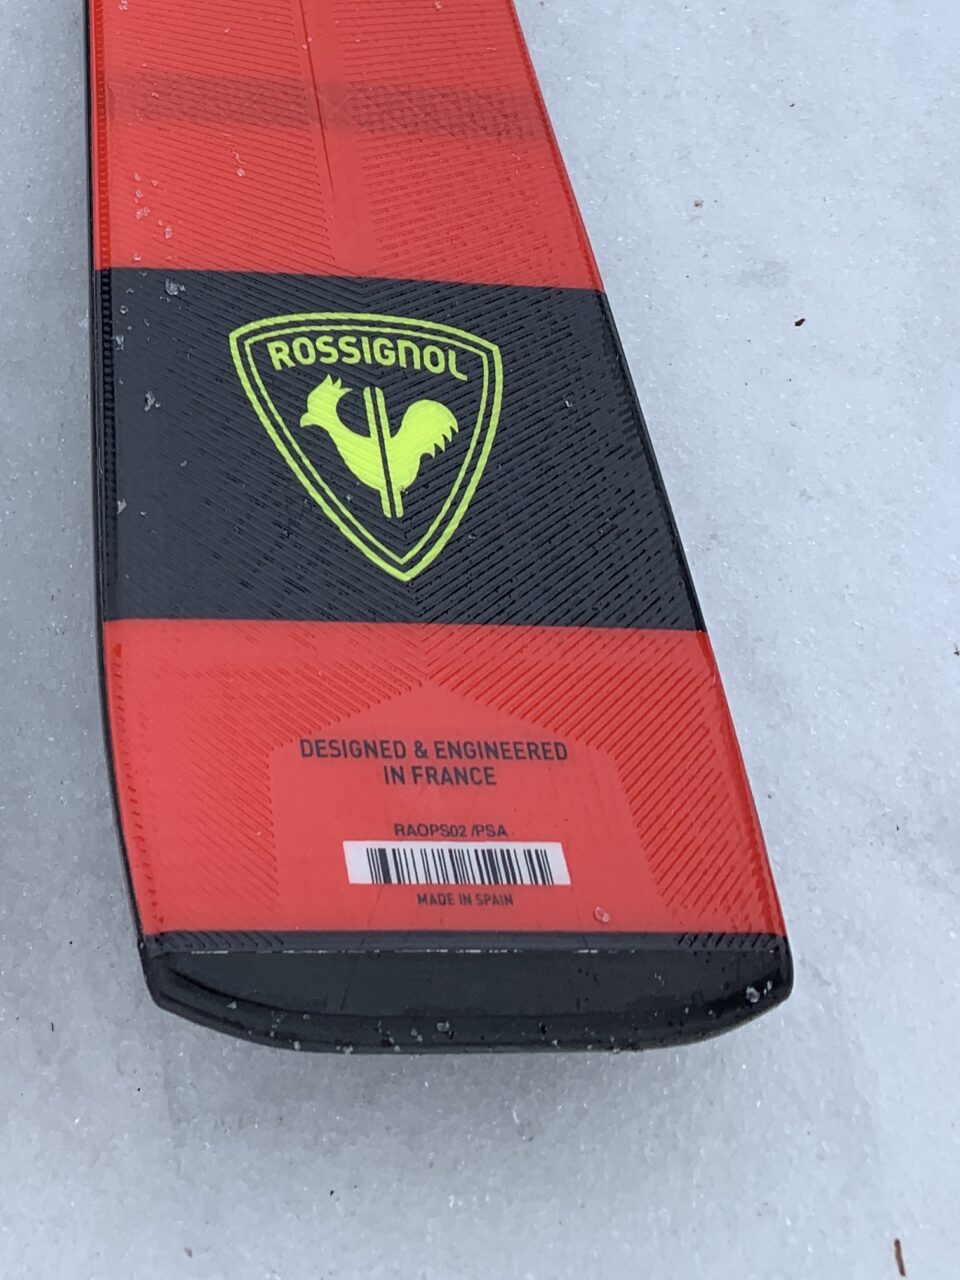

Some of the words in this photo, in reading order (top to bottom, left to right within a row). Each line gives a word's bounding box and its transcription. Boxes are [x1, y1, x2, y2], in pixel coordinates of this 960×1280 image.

[266, 335, 468, 382] ROSSIGNOL
[299, 738, 407, 759] DESIGNED
[413, 740, 429, 759] &
[435, 740, 569, 761] ENGINEERED
[383, 766, 406, 785] IN
[412, 766, 497, 786] FRANCE
[471, 823, 508, 838] /PSA
[416, 892, 455, 906] MADE
[459, 893, 473, 906] IN
[475, 893, 514, 907] SPAIN
